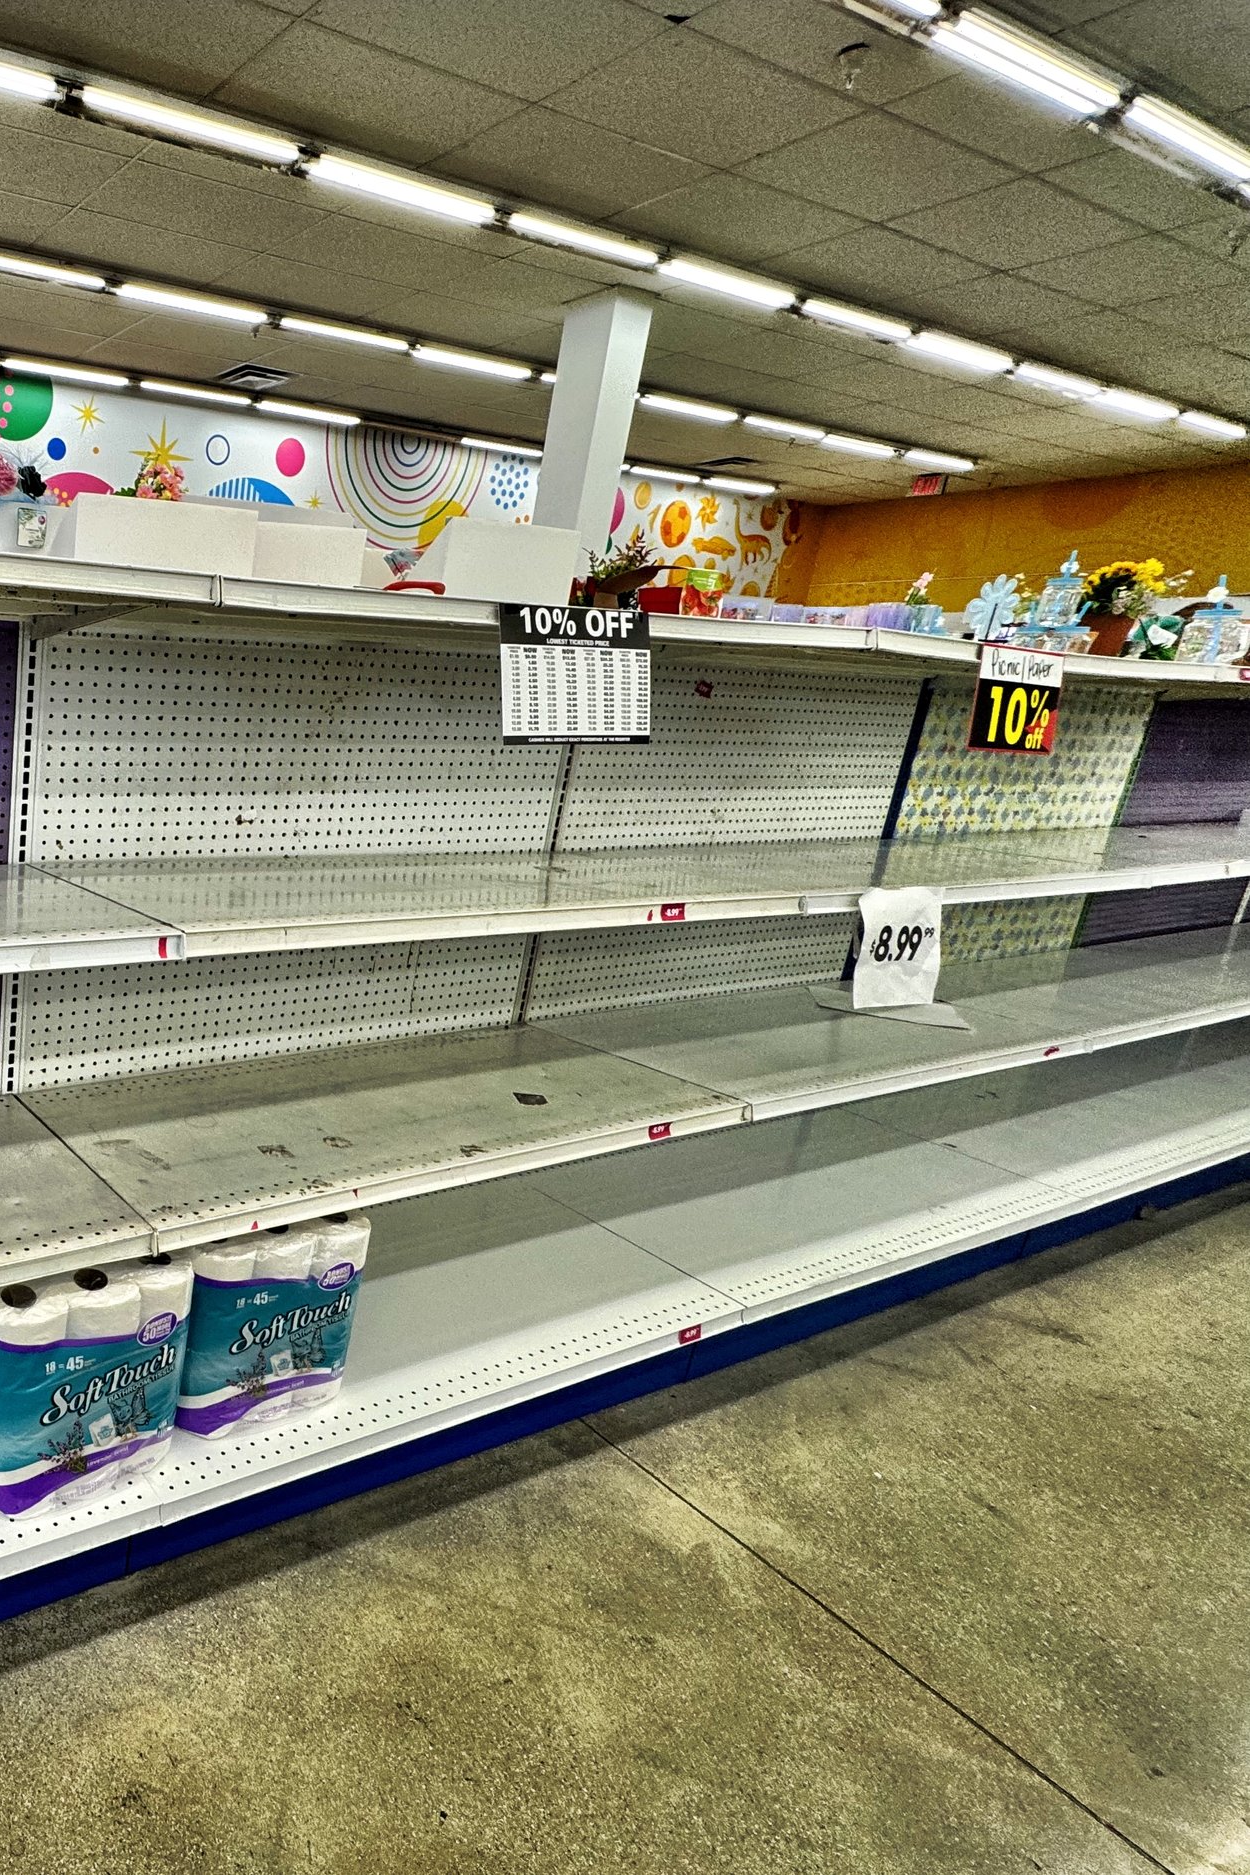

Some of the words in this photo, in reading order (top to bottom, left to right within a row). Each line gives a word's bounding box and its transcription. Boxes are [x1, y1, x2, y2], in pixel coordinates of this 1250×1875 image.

[520, 607, 577, 636] 10%
[585, 610, 634, 638] OFF
[987, 686, 1050, 745] 10%
[1025, 727, 1045, 749] off
[253, 1291, 269, 1306] 45
[231, 1314, 285, 1353] Soft
[287, 1291, 352, 1335] Touch
[45, 1361, 56, 1373] 18
[66, 1356, 85, 1371] 45
[42, 1377, 104, 1424] Soft
[105, 1343, 176, 1394] Touch
